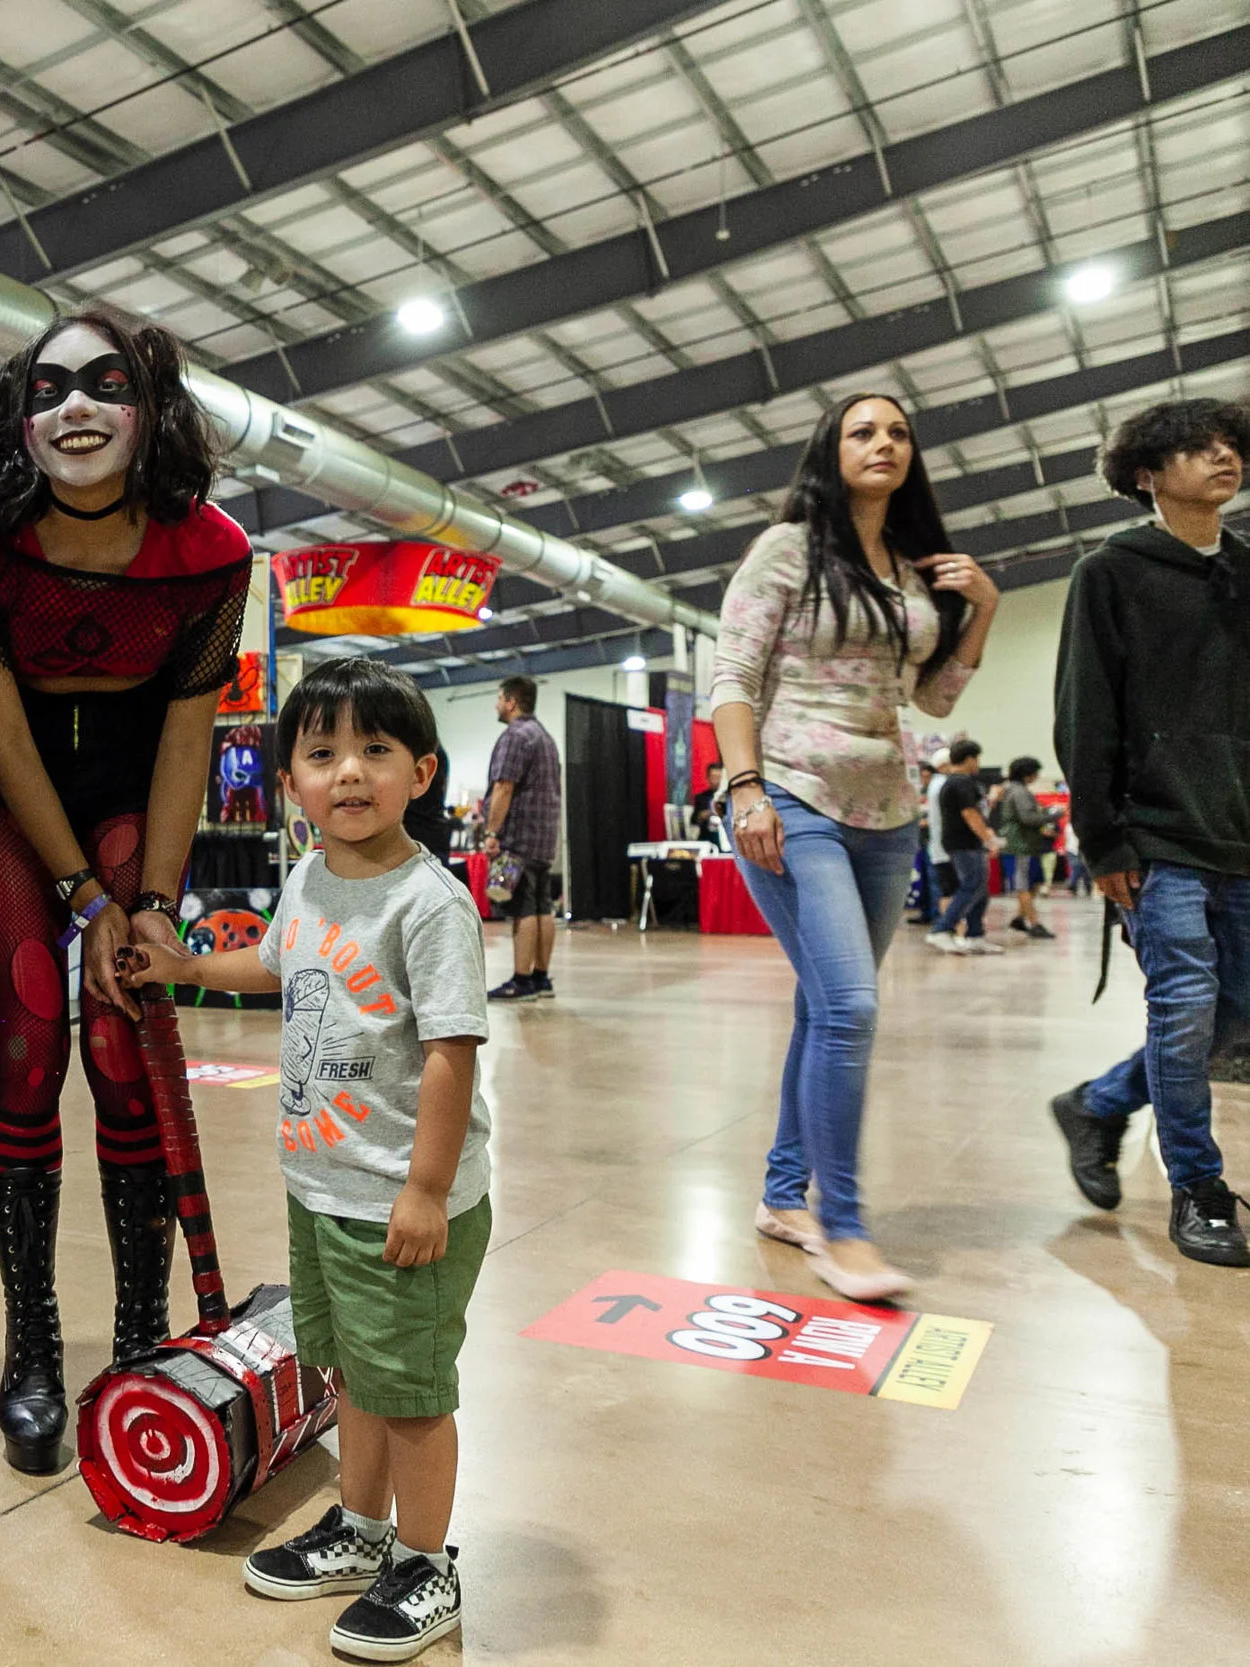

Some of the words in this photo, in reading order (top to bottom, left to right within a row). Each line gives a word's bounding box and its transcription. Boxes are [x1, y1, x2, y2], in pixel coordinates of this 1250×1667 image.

[284, 550, 354, 580] RTIST
[425, 551, 498, 585] ARTIS
[415, 575, 486, 611] ALLEY
[317, 916, 397, 1015] 'BOUT
[318, 1061, 370, 1079] FRESH
[280, 1090, 372, 1153] SOME
[666, 1293, 803, 1361] 600
[790, 1315, 883, 1359] ROW
[913, 1325, 969, 1362] ARTIST
[776, 1349, 856, 1370] A
[895, 1356, 954, 1393] ALLEY
